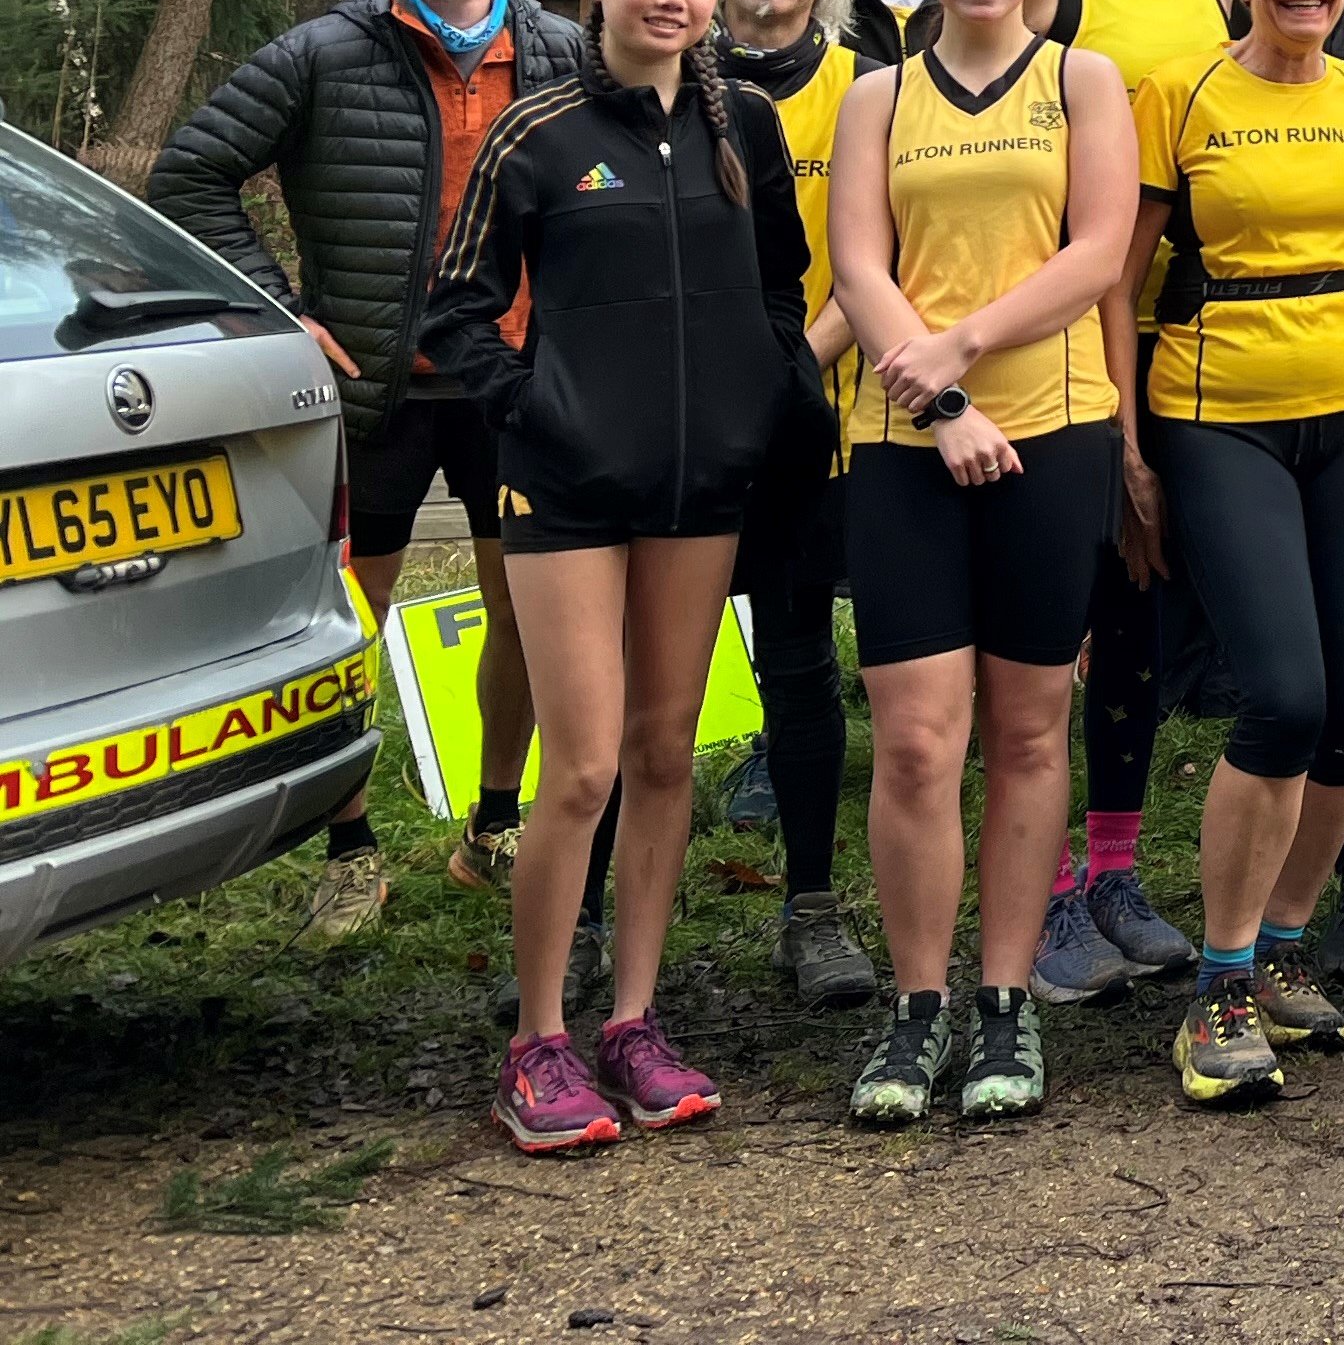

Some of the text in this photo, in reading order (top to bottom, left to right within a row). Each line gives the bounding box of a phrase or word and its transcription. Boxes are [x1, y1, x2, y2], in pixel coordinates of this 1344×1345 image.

[1205, 128, 1279, 150] ALTON
[895, 137, 1053, 168] ALTON RUNNERS
[576, 178, 625, 191] adidas
